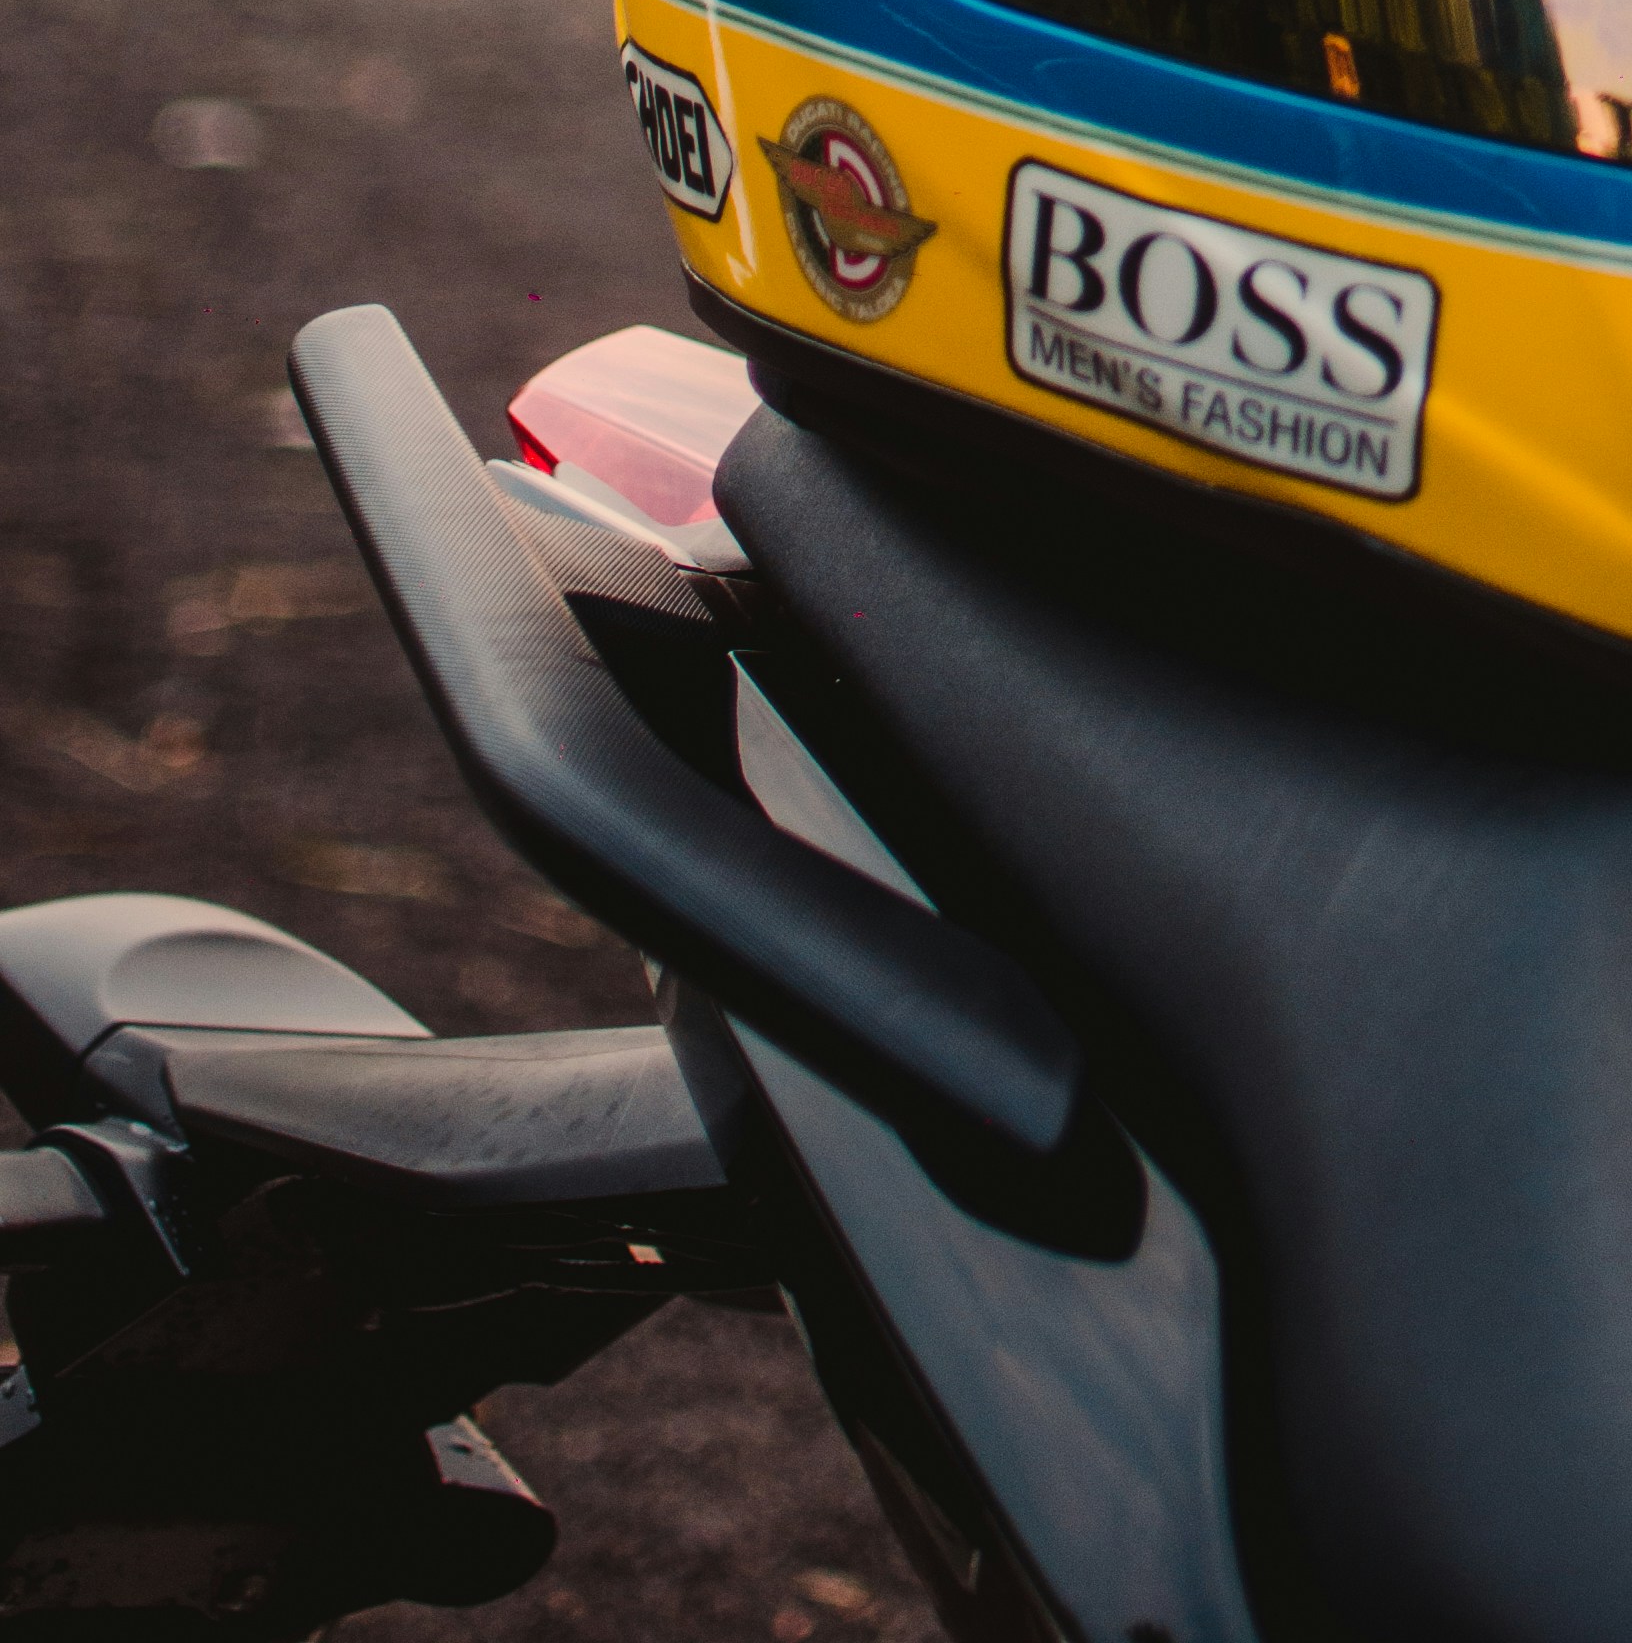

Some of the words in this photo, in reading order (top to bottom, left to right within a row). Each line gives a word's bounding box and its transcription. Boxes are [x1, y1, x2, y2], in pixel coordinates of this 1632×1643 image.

[1028, 189, 1404, 401] BOSS
[1030, 322, 1163, 413] MEN'S
[1180, 382, 1391, 478] FASHION
